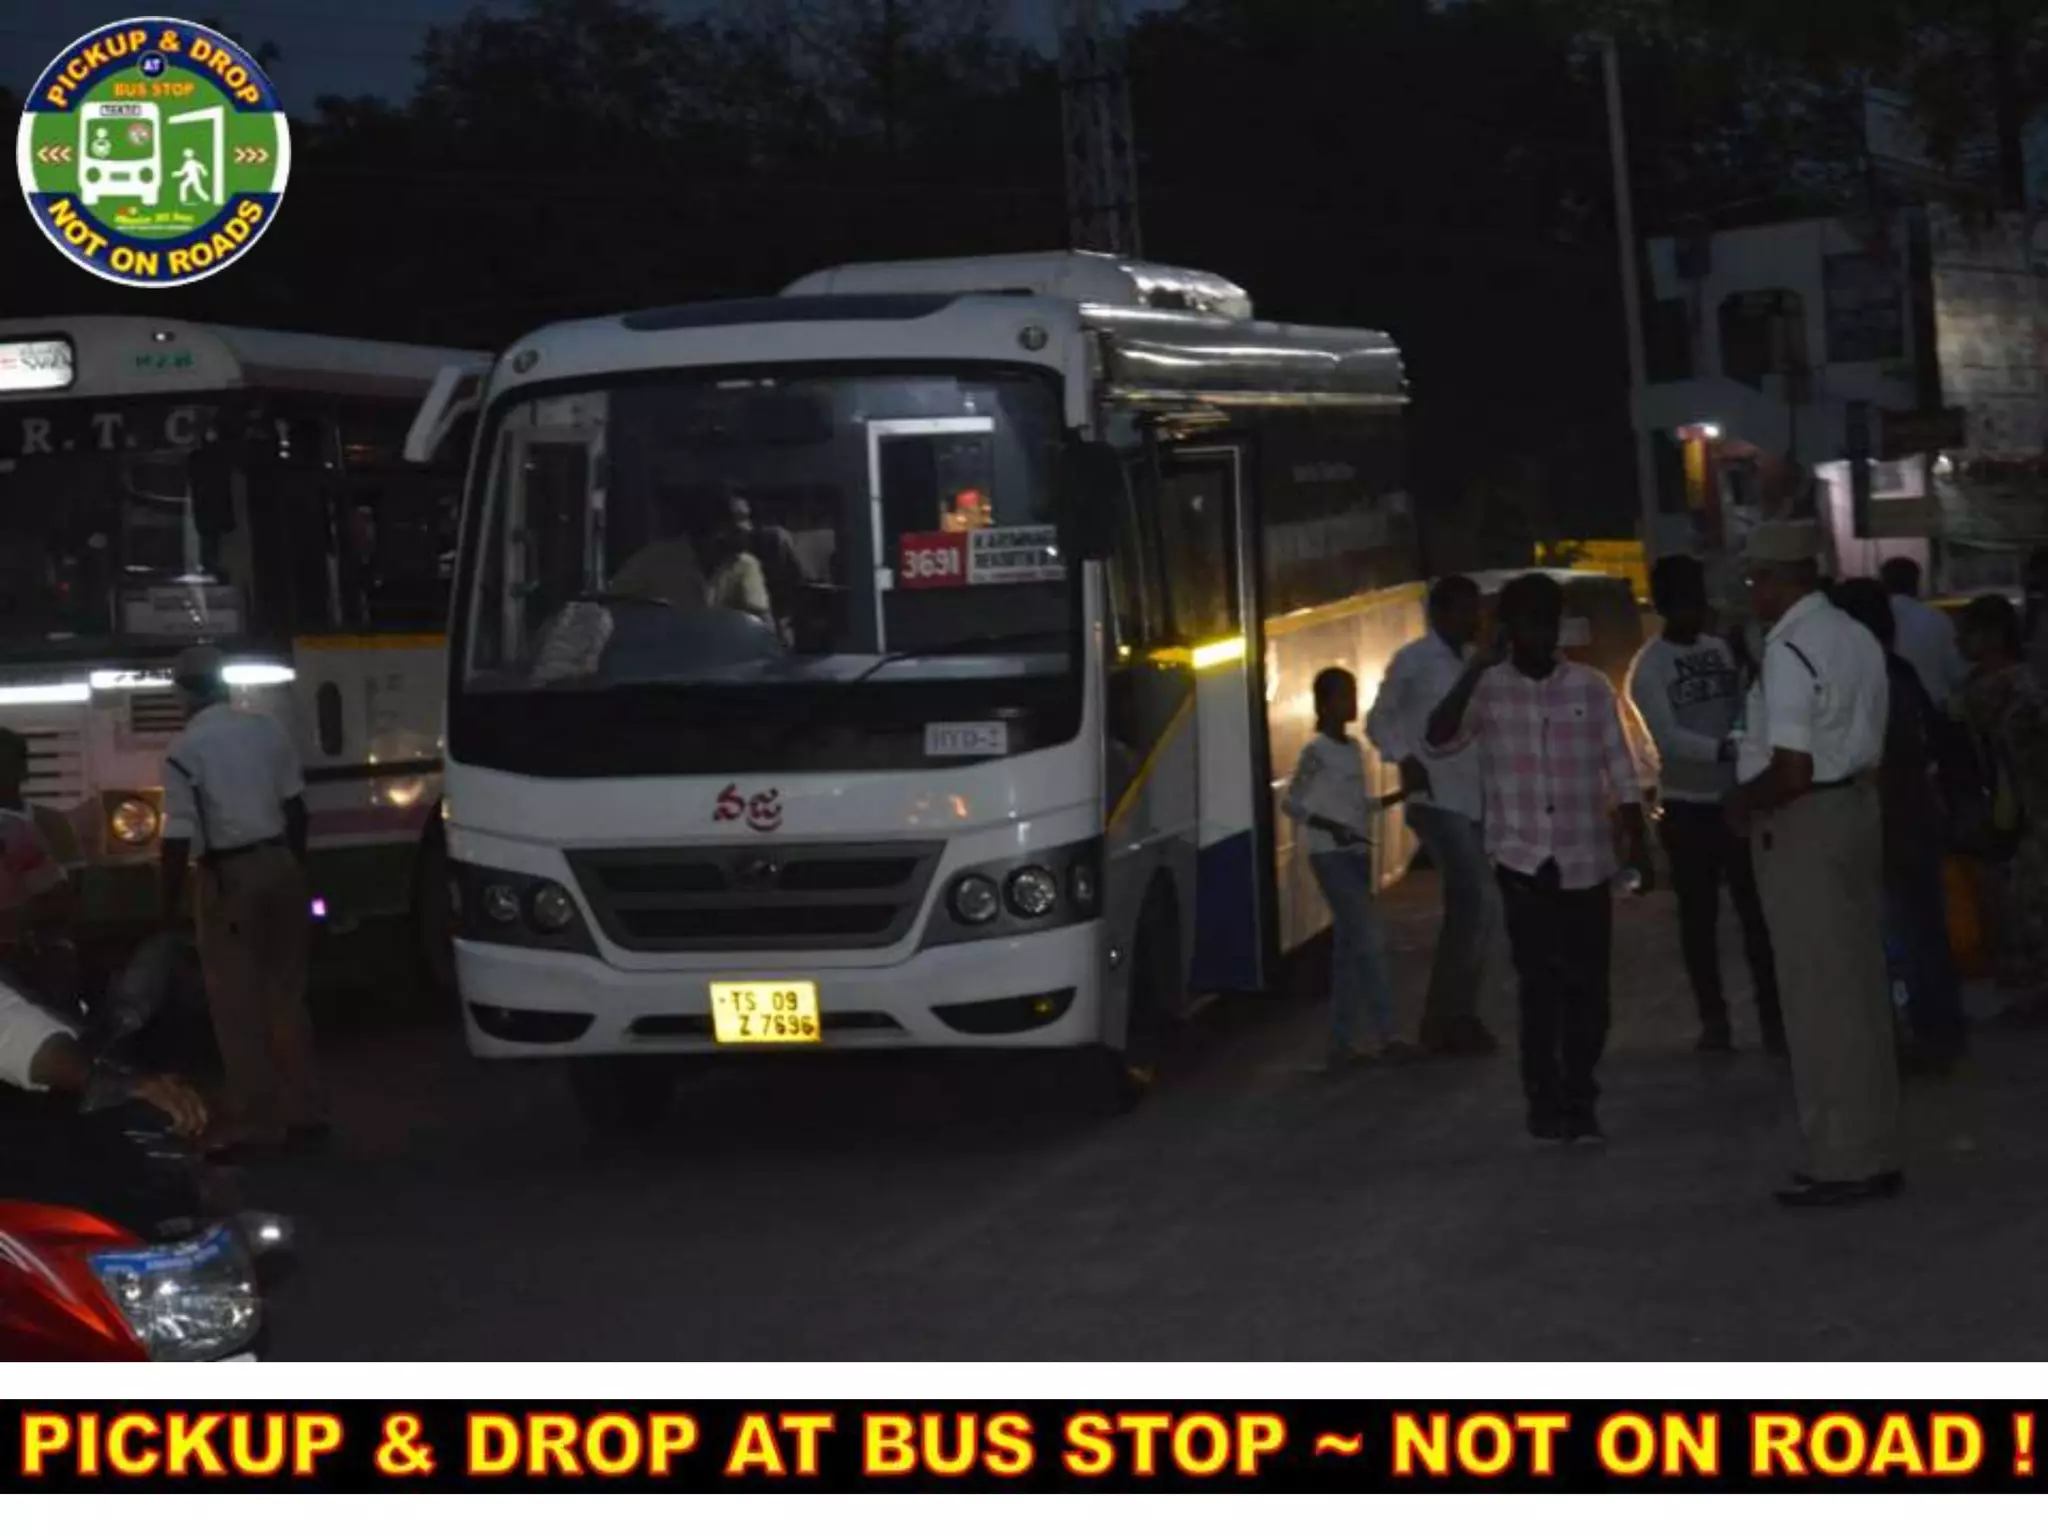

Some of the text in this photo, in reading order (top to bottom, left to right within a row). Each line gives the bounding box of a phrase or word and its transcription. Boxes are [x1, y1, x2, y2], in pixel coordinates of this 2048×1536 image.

[903, 548, 961, 579] 3691
[731, 990, 797, 1011] TS 09
[739, 1015, 751, 1035] Z
